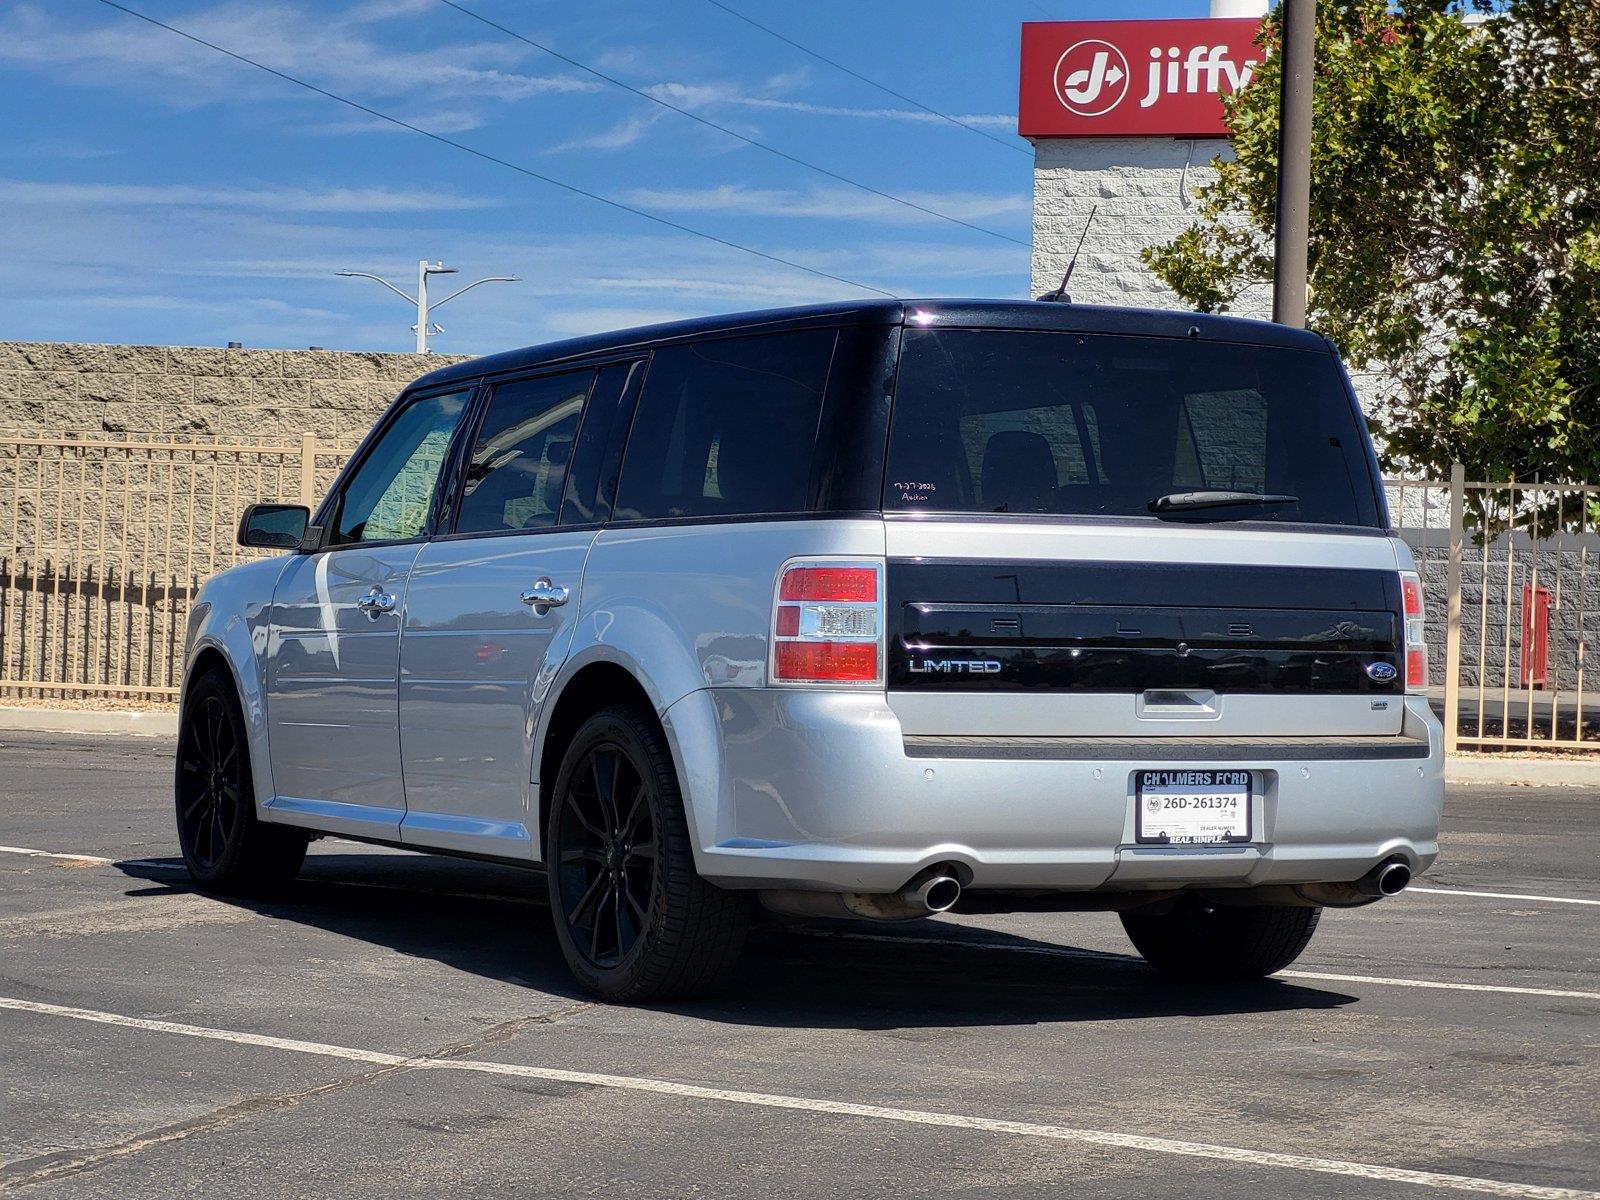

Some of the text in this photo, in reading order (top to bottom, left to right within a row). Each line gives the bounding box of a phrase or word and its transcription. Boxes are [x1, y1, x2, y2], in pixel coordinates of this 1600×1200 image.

[1140, 45, 1257, 107] jiffy
[909, 659, 1001, 673] LIMITED
[1163, 797, 1237, 809] 26D-261374
[1169, 836, 1190, 844] REAL
